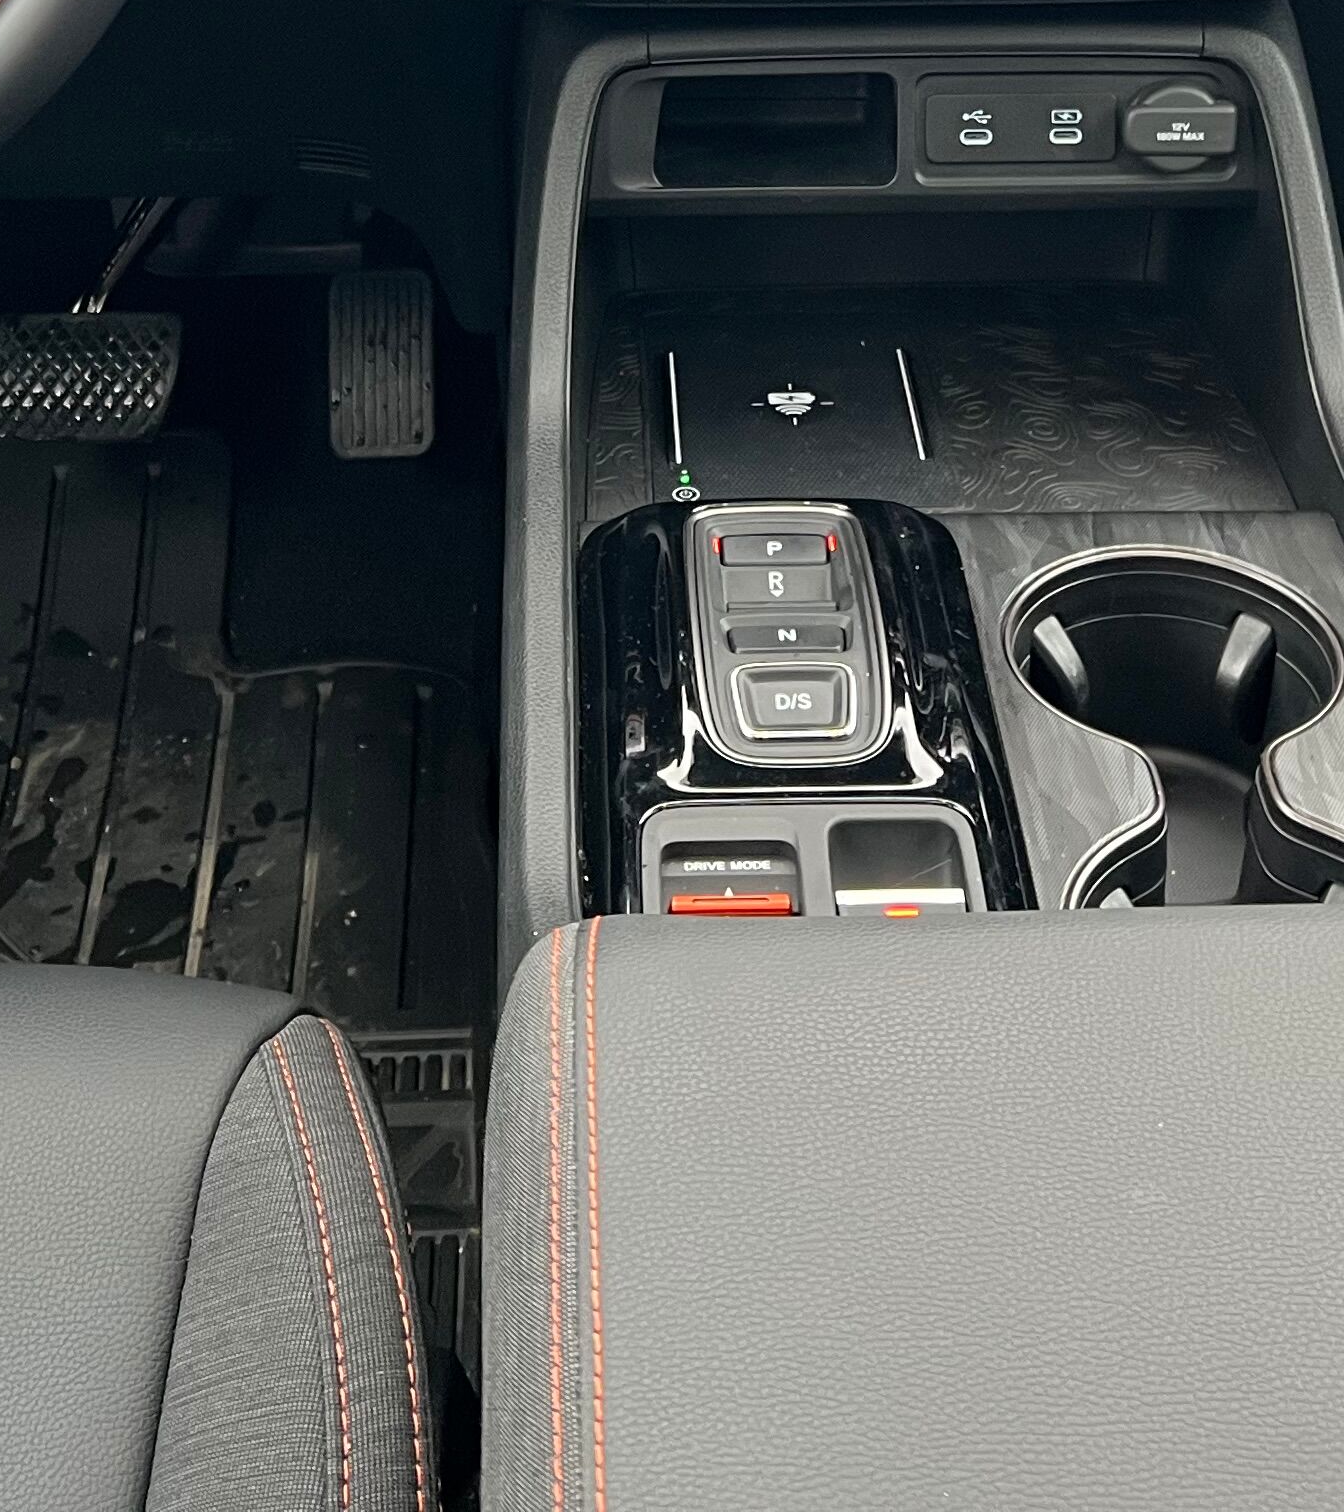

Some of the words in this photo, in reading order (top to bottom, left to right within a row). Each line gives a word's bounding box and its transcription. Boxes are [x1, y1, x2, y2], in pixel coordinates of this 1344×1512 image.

[1182, 132, 1205, 141] MAX
[766, 540, 783, 557] P
[767, 571, 785, 590] R
[777, 628, 798, 643] N
[774, 692, 813, 711] D/S
[683, 861, 726, 872] DRIVE
[730, 859, 771, 871] MODE
